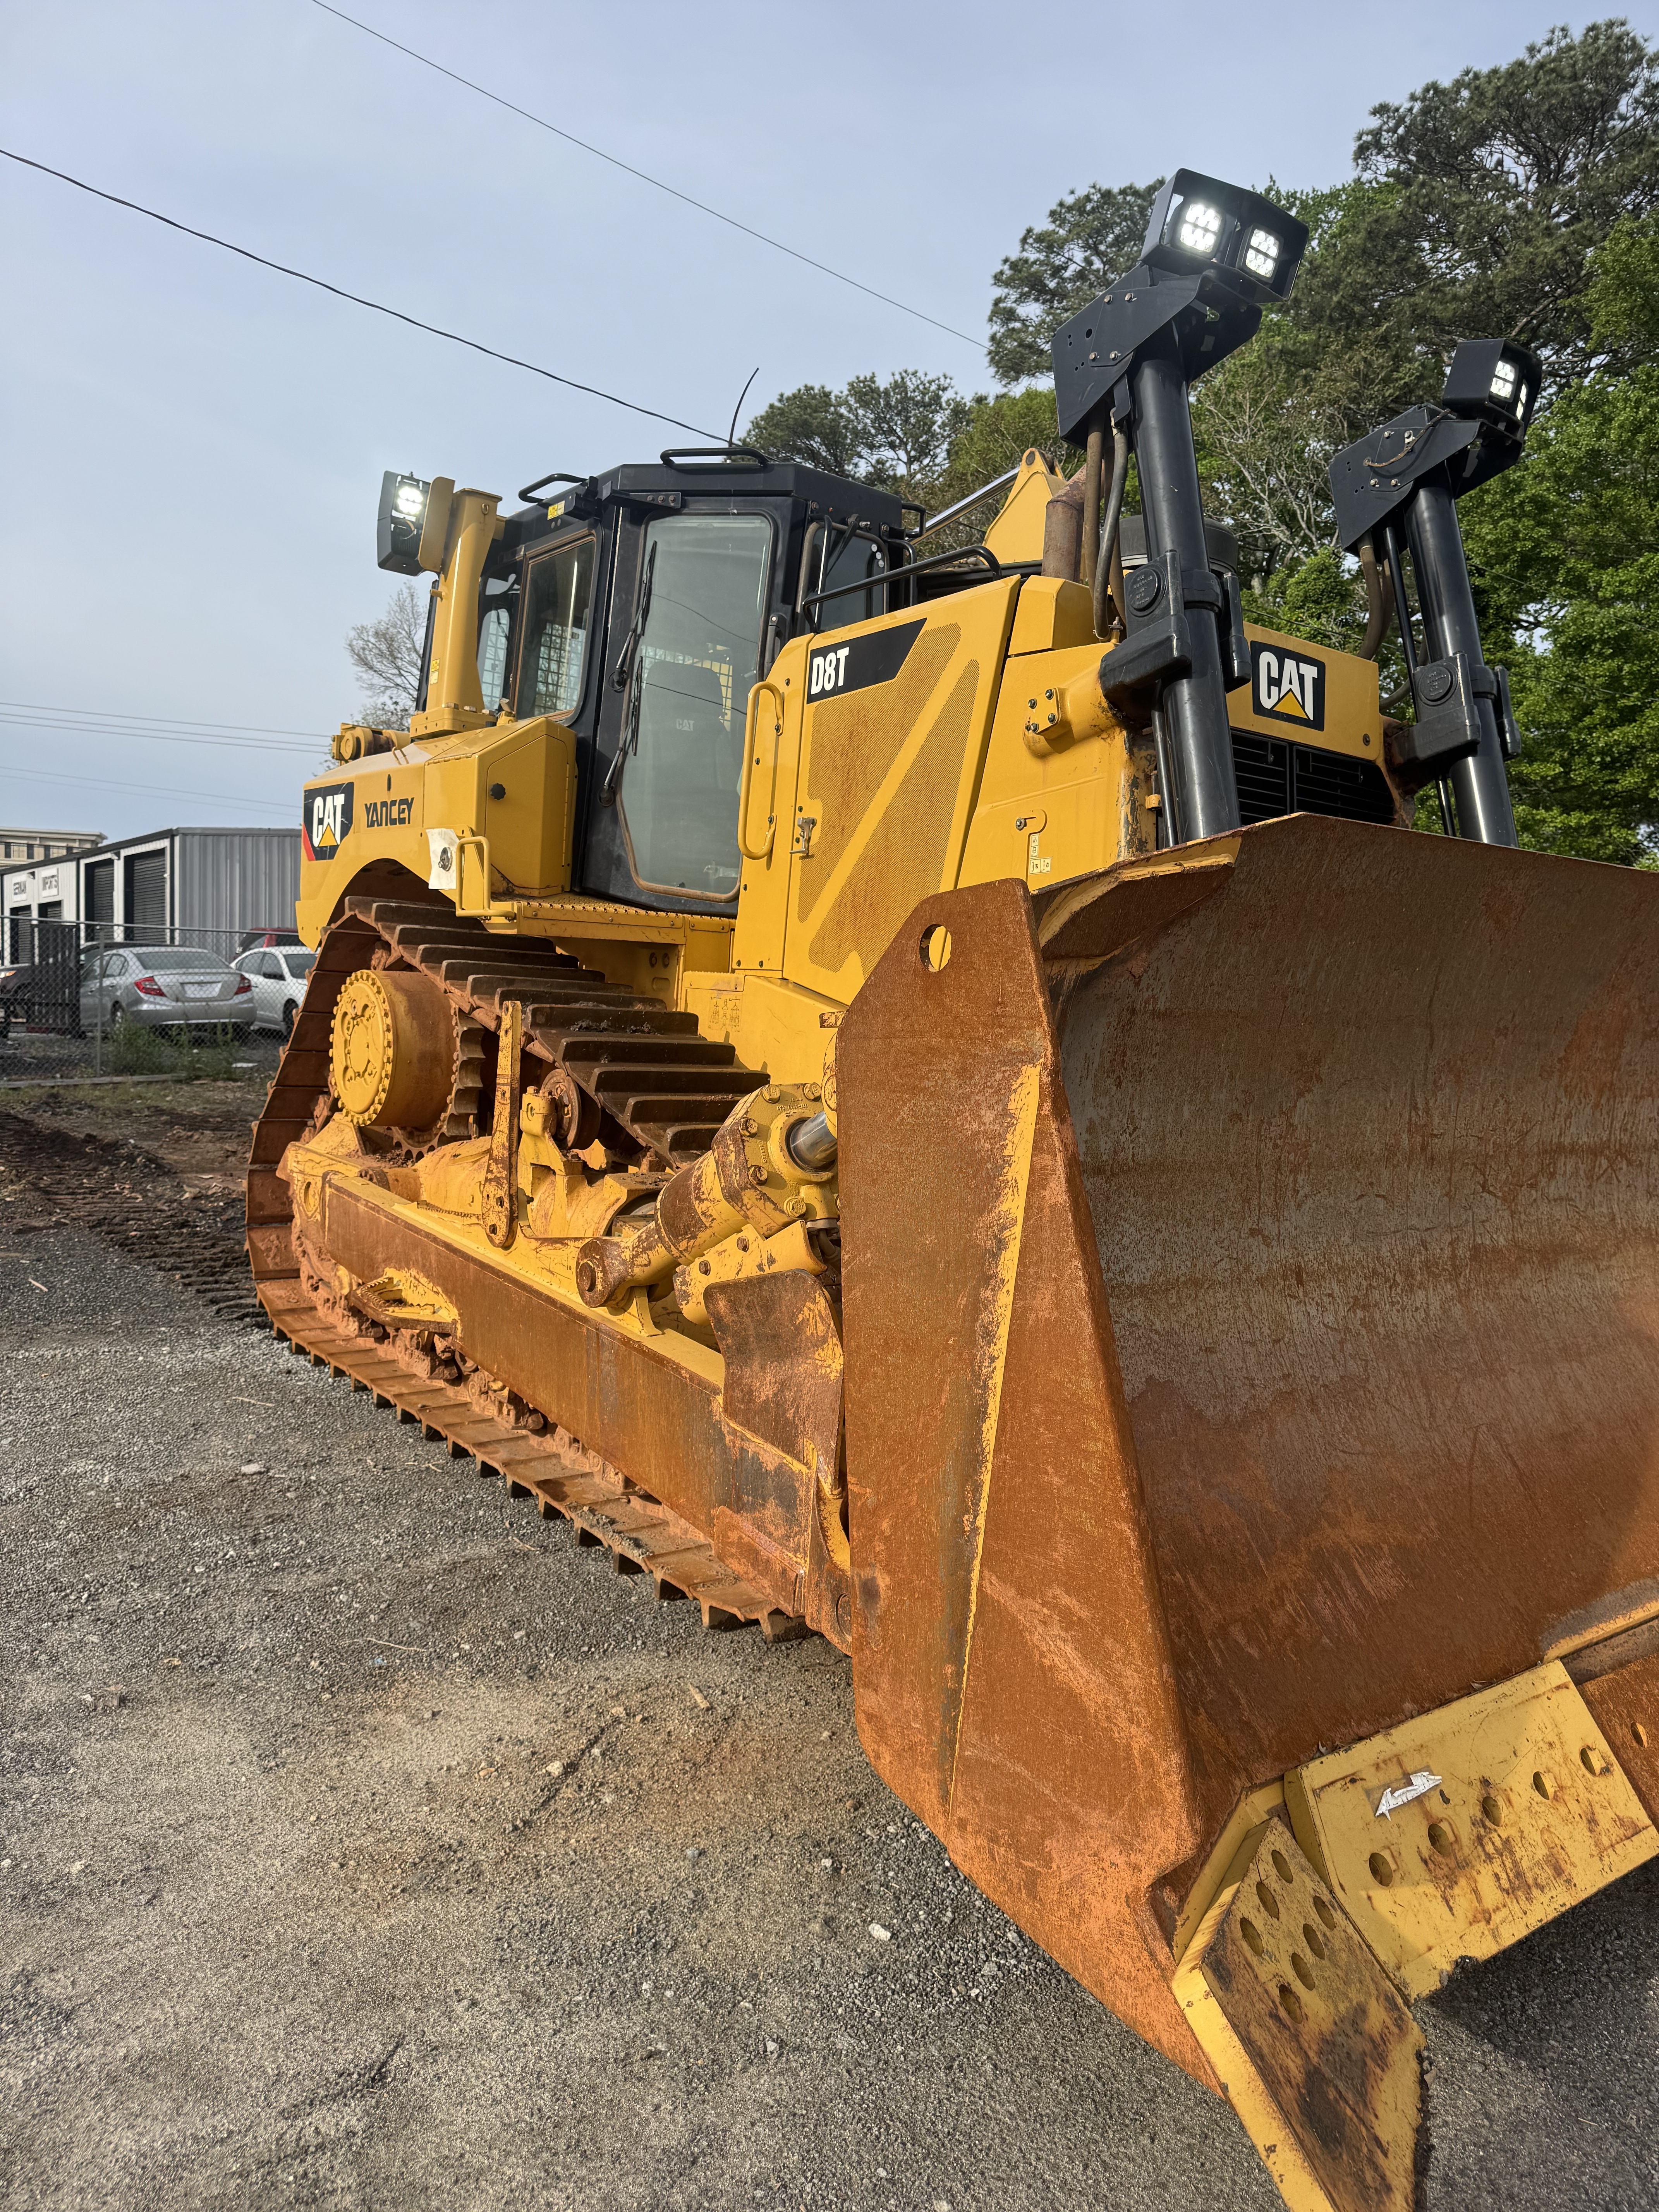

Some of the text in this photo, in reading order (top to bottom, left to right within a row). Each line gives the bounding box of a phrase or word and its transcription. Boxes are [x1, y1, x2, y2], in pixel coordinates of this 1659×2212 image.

[811, 647, 849, 695] D8T
[1259, 651, 1317, 721] CAT
[676, 718, 694, 731] CAT
[313, 794, 345, 847] CAT
[364, 797, 414, 828] YANCEY
